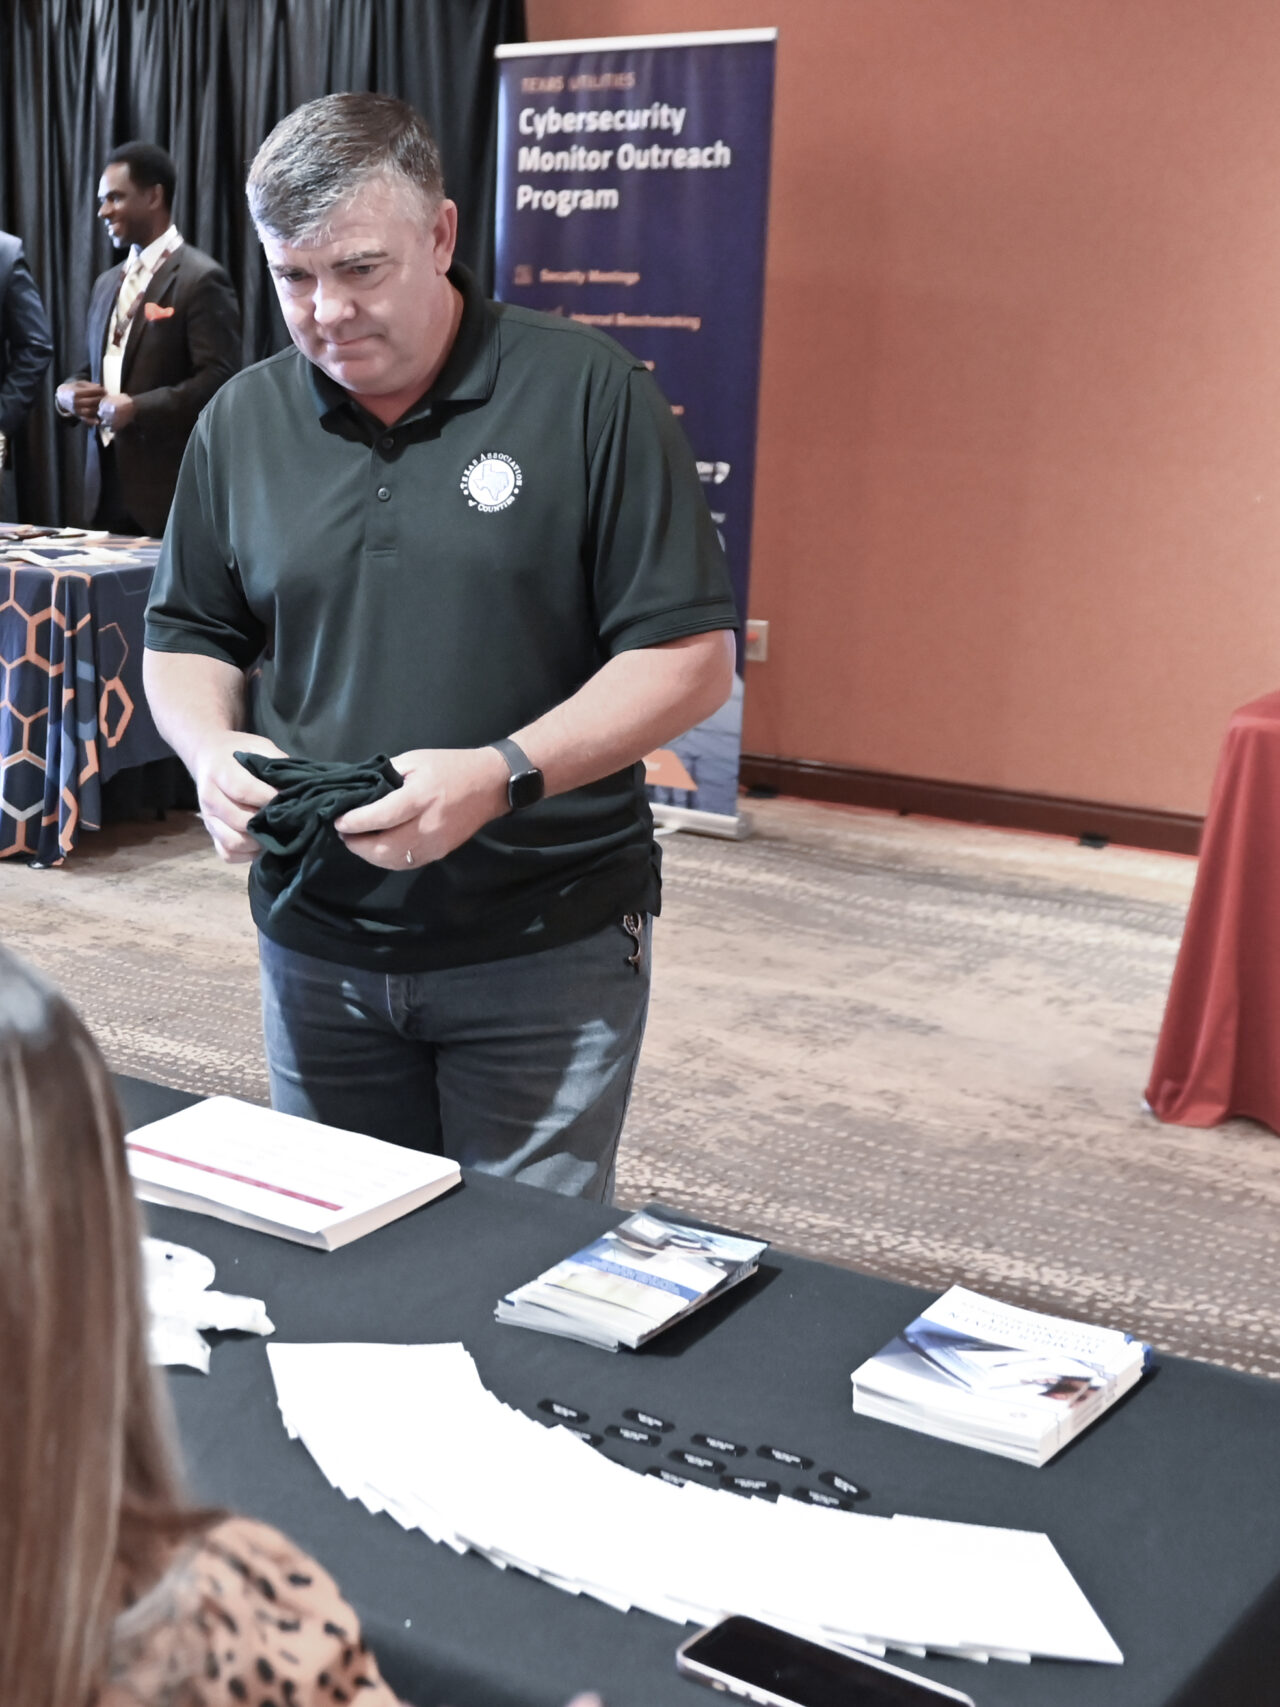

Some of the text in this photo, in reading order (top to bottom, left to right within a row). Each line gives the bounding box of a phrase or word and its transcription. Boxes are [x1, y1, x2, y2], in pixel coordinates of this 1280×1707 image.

[519, 102, 686, 140] Cybersecurity
[517, 140, 731, 173] Monitor Outreach
[516, 184, 619, 218] Program
